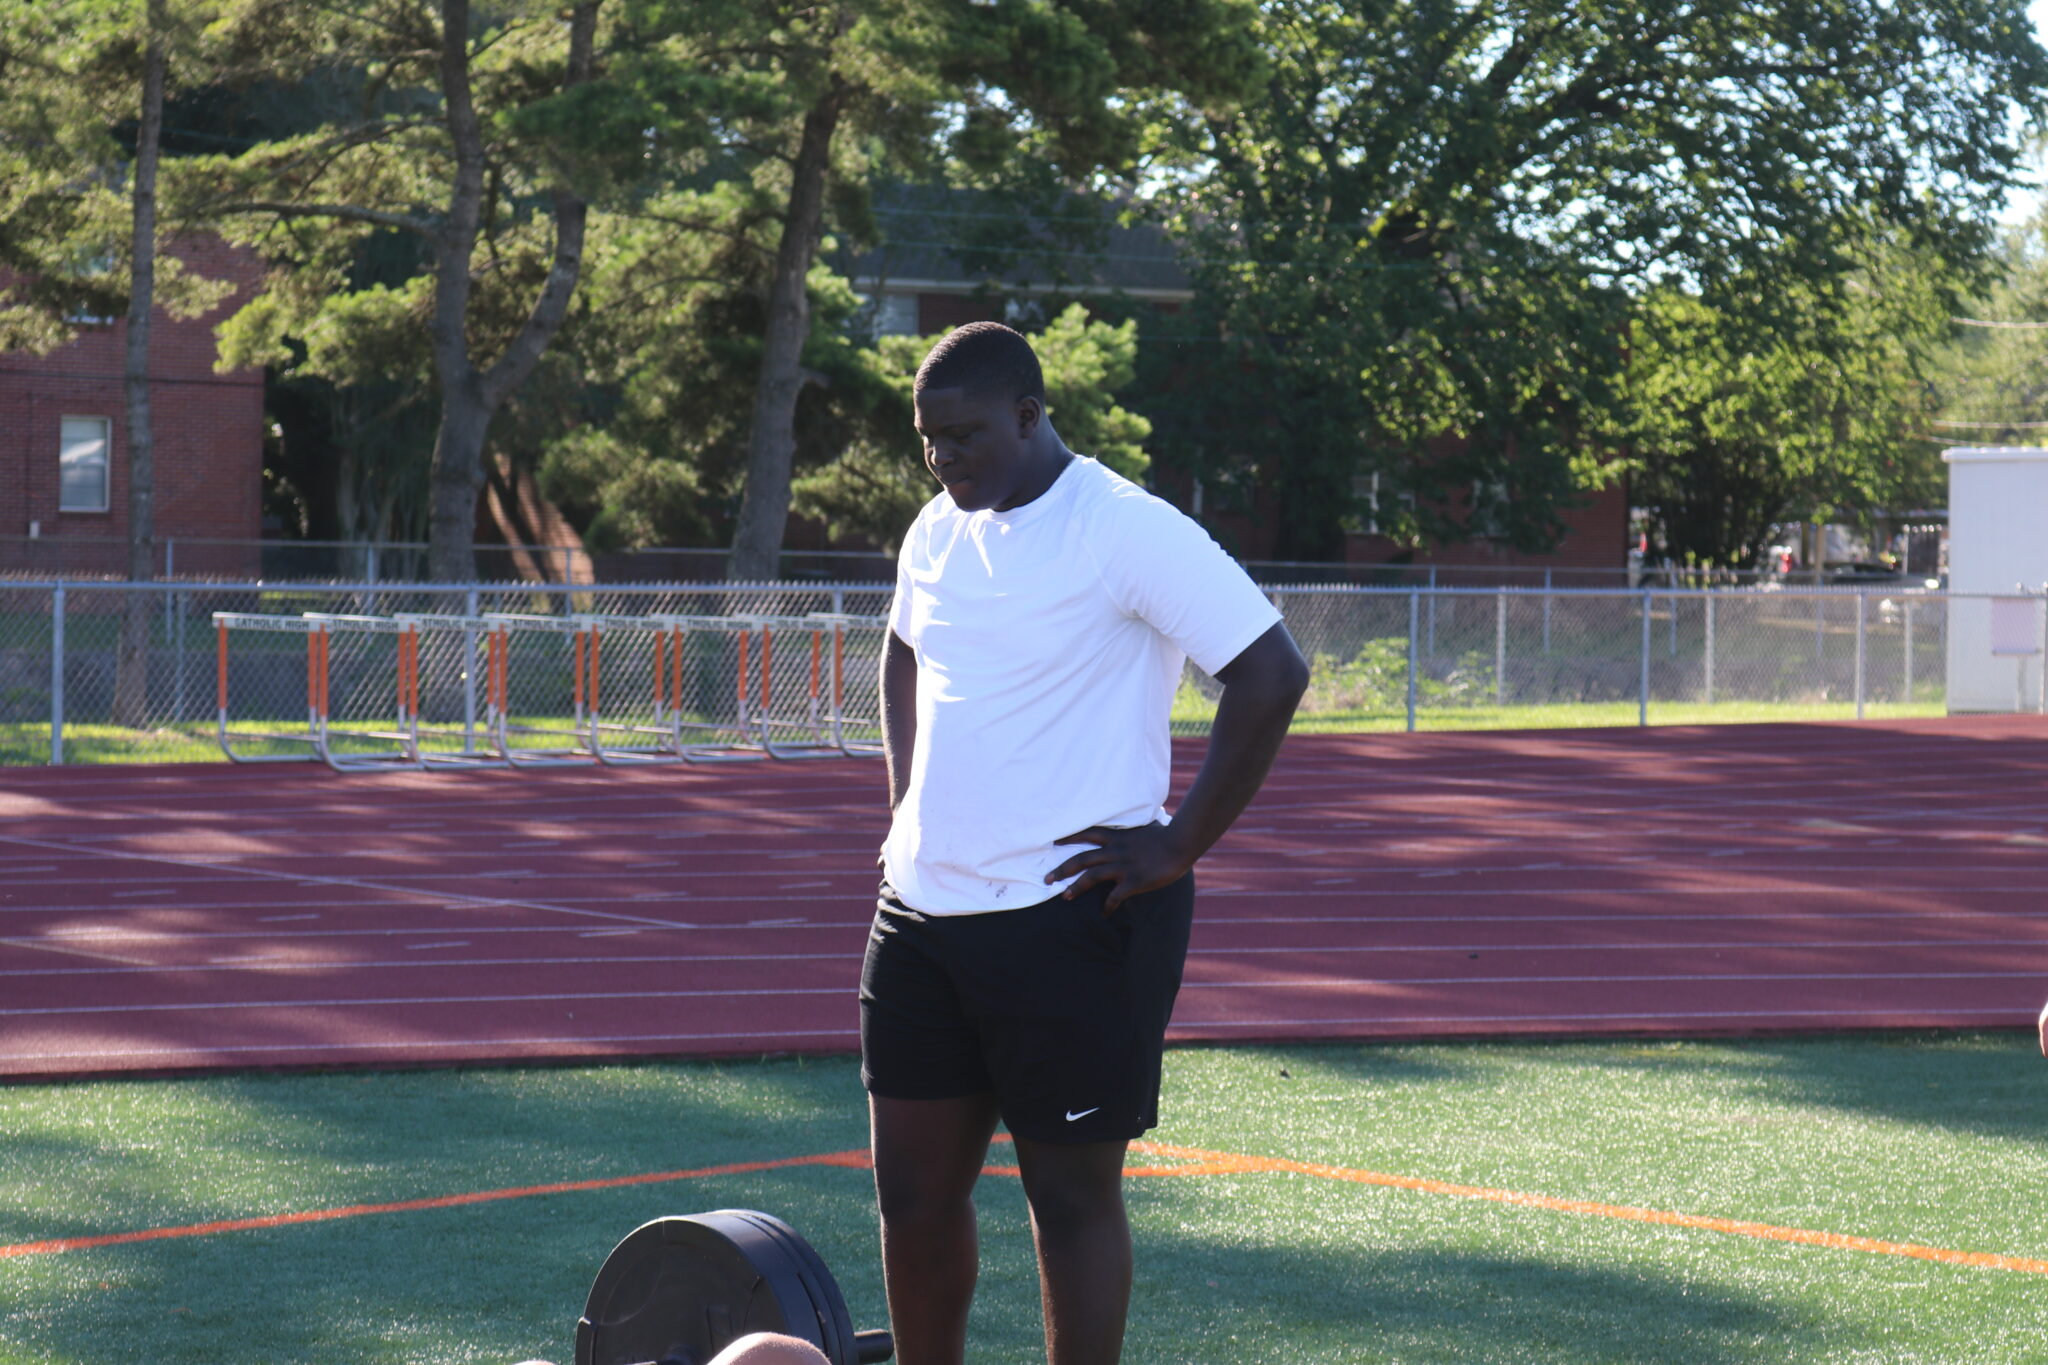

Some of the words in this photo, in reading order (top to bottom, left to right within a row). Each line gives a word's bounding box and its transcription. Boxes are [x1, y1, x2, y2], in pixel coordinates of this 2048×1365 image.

[234, 618, 280, 629] CATHOLIC
[285, 620, 309, 630] HIGH
[423, 619, 461, 629] ATHOLIC
[512, 619, 553, 629] ATHOLIC
